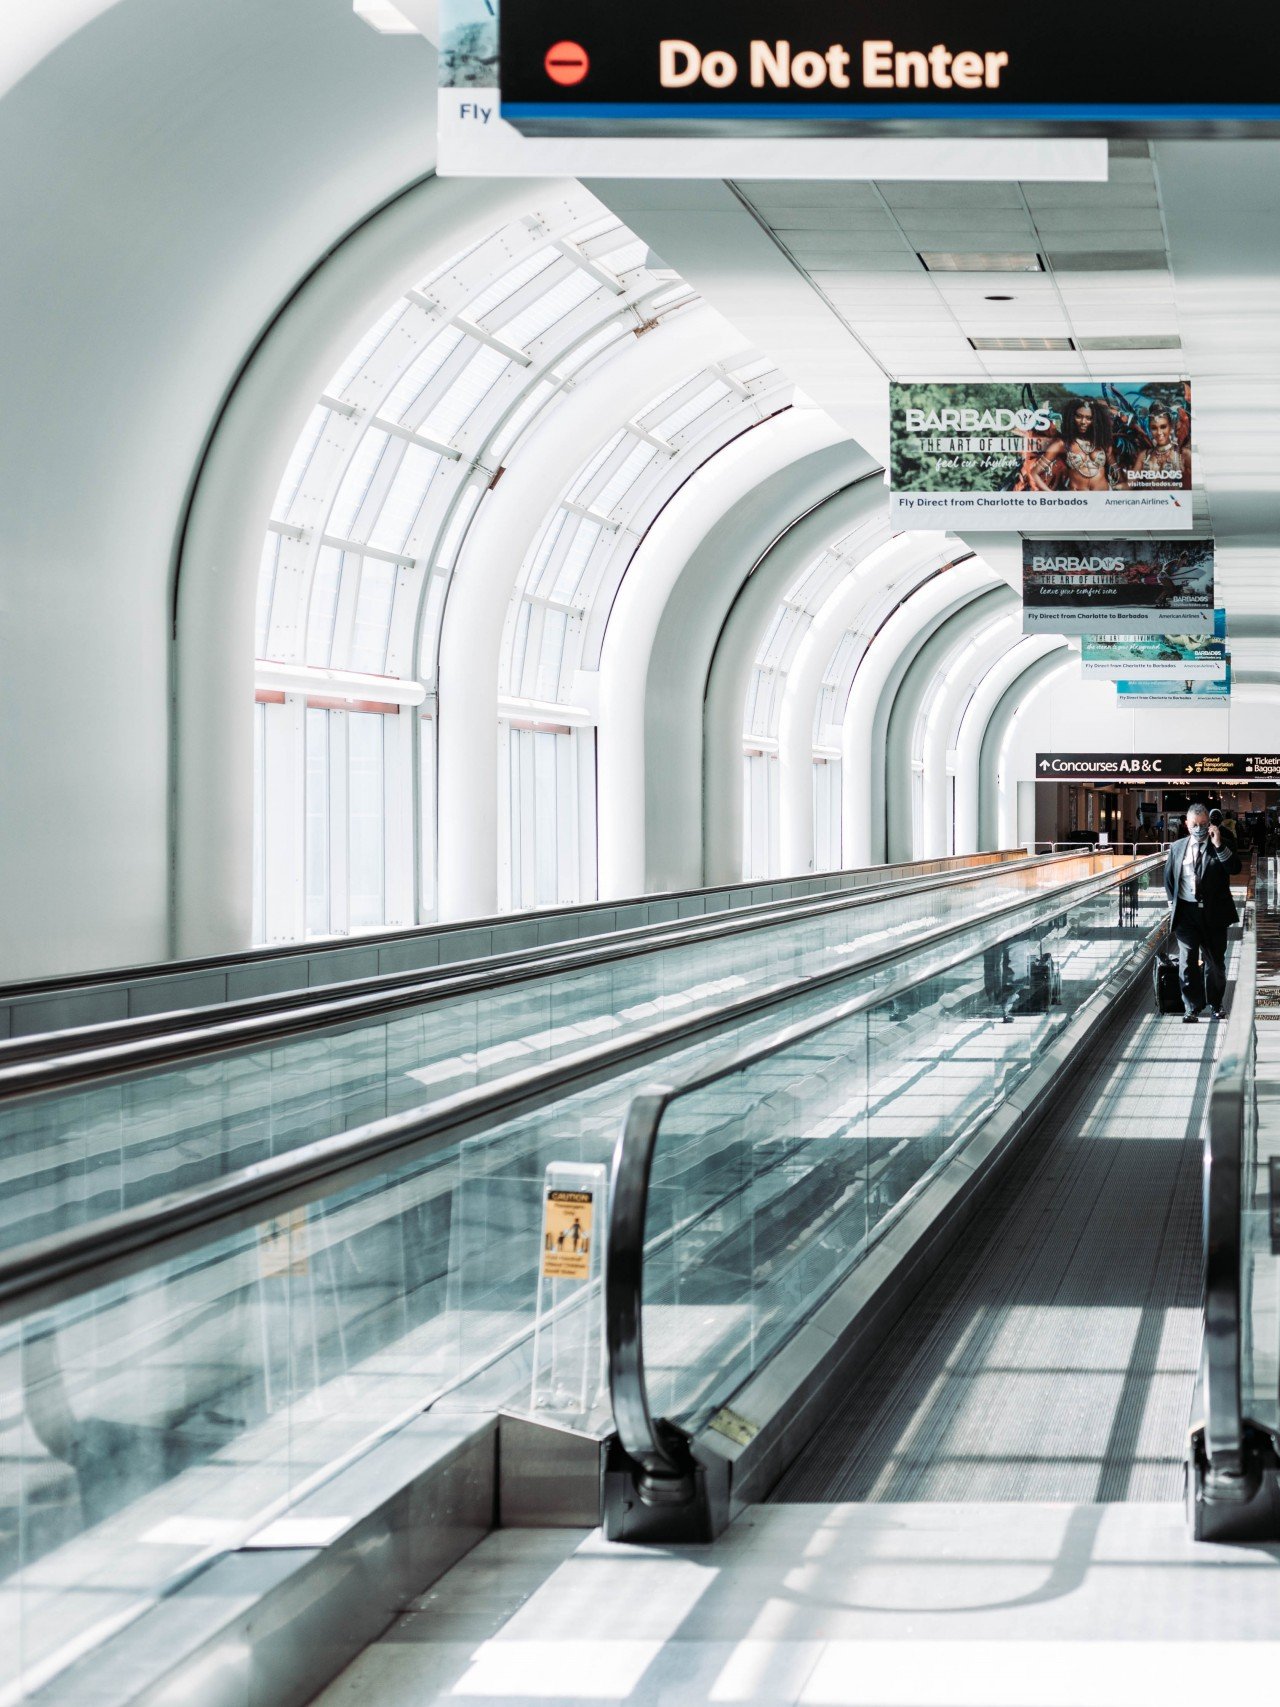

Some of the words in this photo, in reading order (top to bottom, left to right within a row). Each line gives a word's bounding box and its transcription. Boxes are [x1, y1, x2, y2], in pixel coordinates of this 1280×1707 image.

[659, 39, 738, 89] Do
[750, 39, 850, 89] Not
[863, 39, 1009, 89] Enter
[461, 104, 492, 124] Fly
[905, 408, 1051, 432] BARBADOS
[920, 438, 942, 451] THE
[950, 438, 971, 451] ART
[979, 438, 993, 451] OF
[1000, 438, 1043, 452] LIVING
[935, 456, 959, 472] feel
[1127, 470, 1182, 480] BARBADOS
[899, 498, 914, 509] Fly
[917, 498, 948, 507] Direct
[950, 498, 974, 507] from
[976, 498, 1025, 507] Charlotte
[1027, 499, 1038, 507] to
[1040, 498, 1088, 506] Barbados
[1105, 498, 1140, 506] American
[1141, 498, 1169, 506] Airlines
[1033, 557, 1125, 571] BARBADOS
[1041, 575, 1056, 584] THE
[1061, 575, 1074, 584] ART
[1079, 575, 1088, 584] OF
[1092, 575, 1120, 584] LIVING
[1028, 613, 1038, 621] Fly
[1051, 759, 1118, 772] Concourses
[1119, 759, 1140, 773] A,B
[1141, 760, 1151, 772] &
[1152, 760, 1162, 772] C
[552, 1192, 589, 1201] CAUTION
